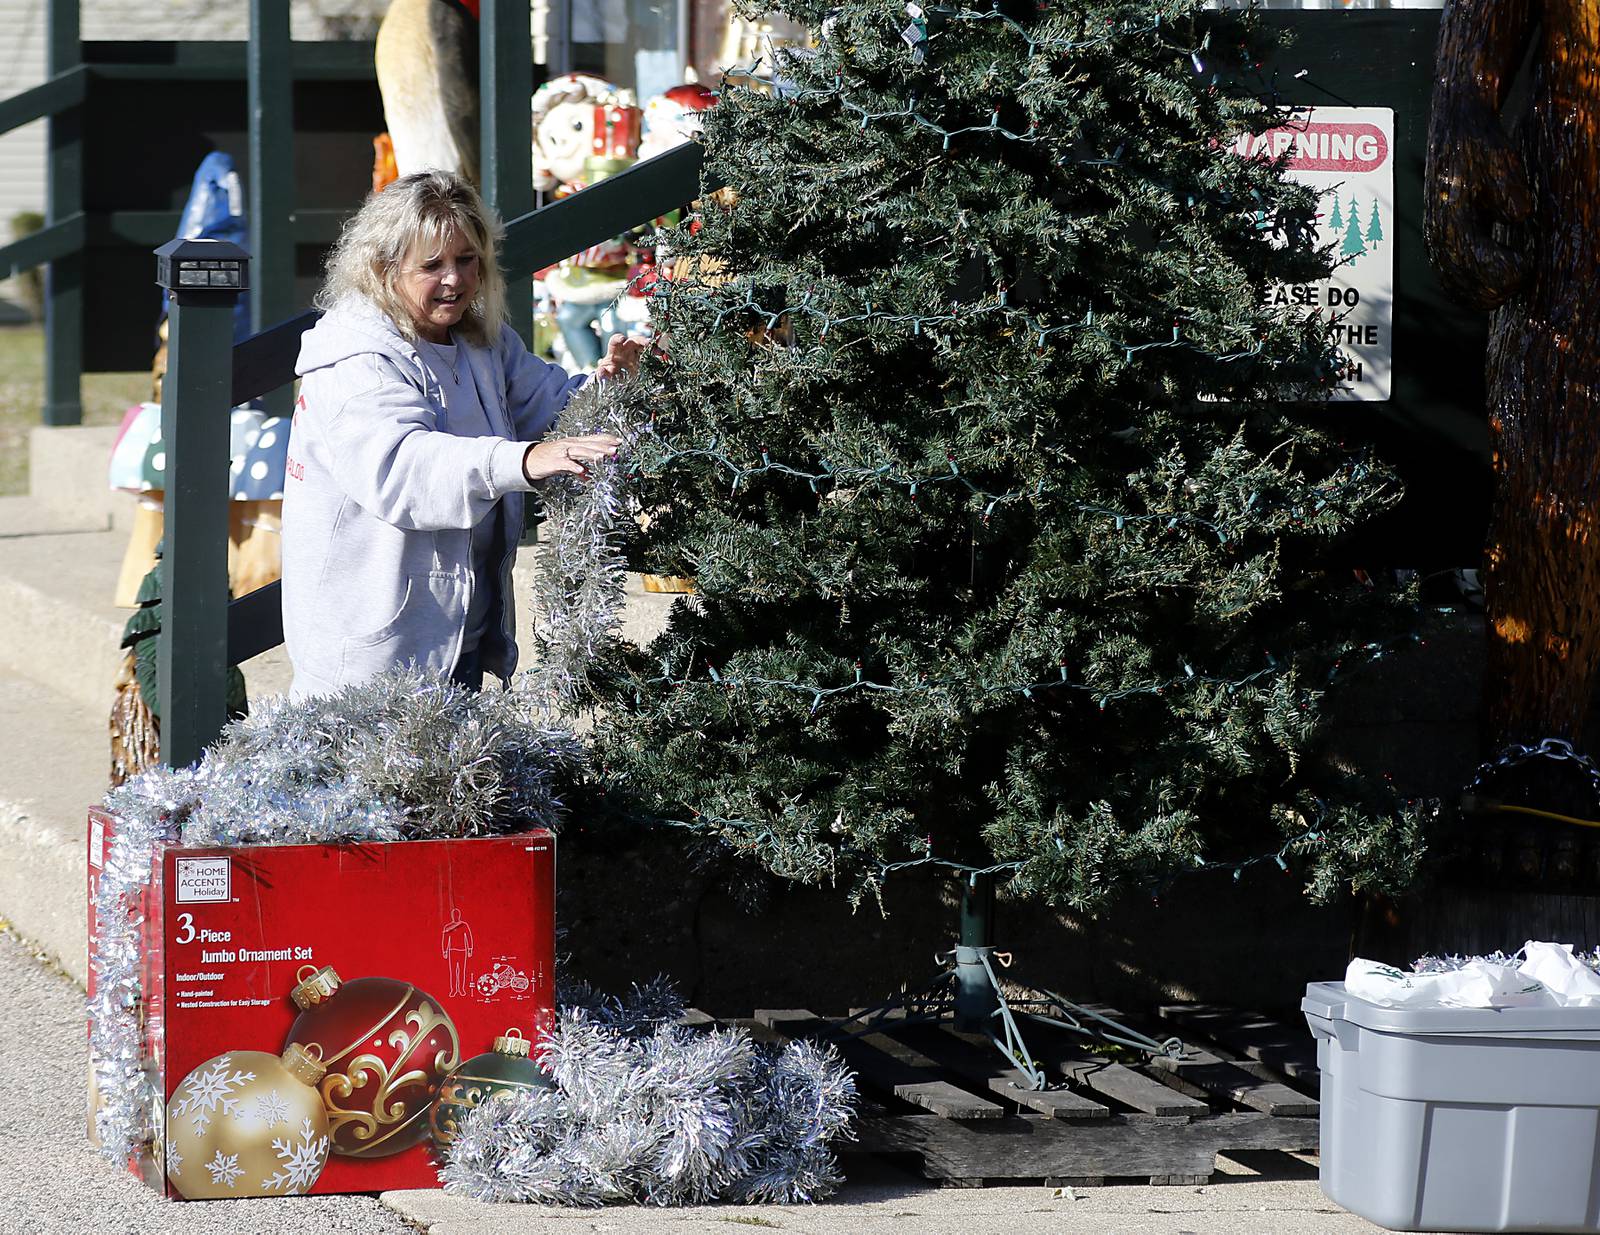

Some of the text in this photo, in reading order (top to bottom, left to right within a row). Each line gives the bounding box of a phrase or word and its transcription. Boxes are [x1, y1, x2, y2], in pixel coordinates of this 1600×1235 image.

[1264, 286, 1360, 307] EASE DO
[1333, 325, 1378, 345] THE
[196, 867, 227, 876] HOME
[180, 878, 226, 887] ACCENTS
[193, 888, 226, 897] Holiday
[200, 946, 313, 964] Jumbo Ornament Set
[176, 972, 224, 982] Indoor/Outdoor
